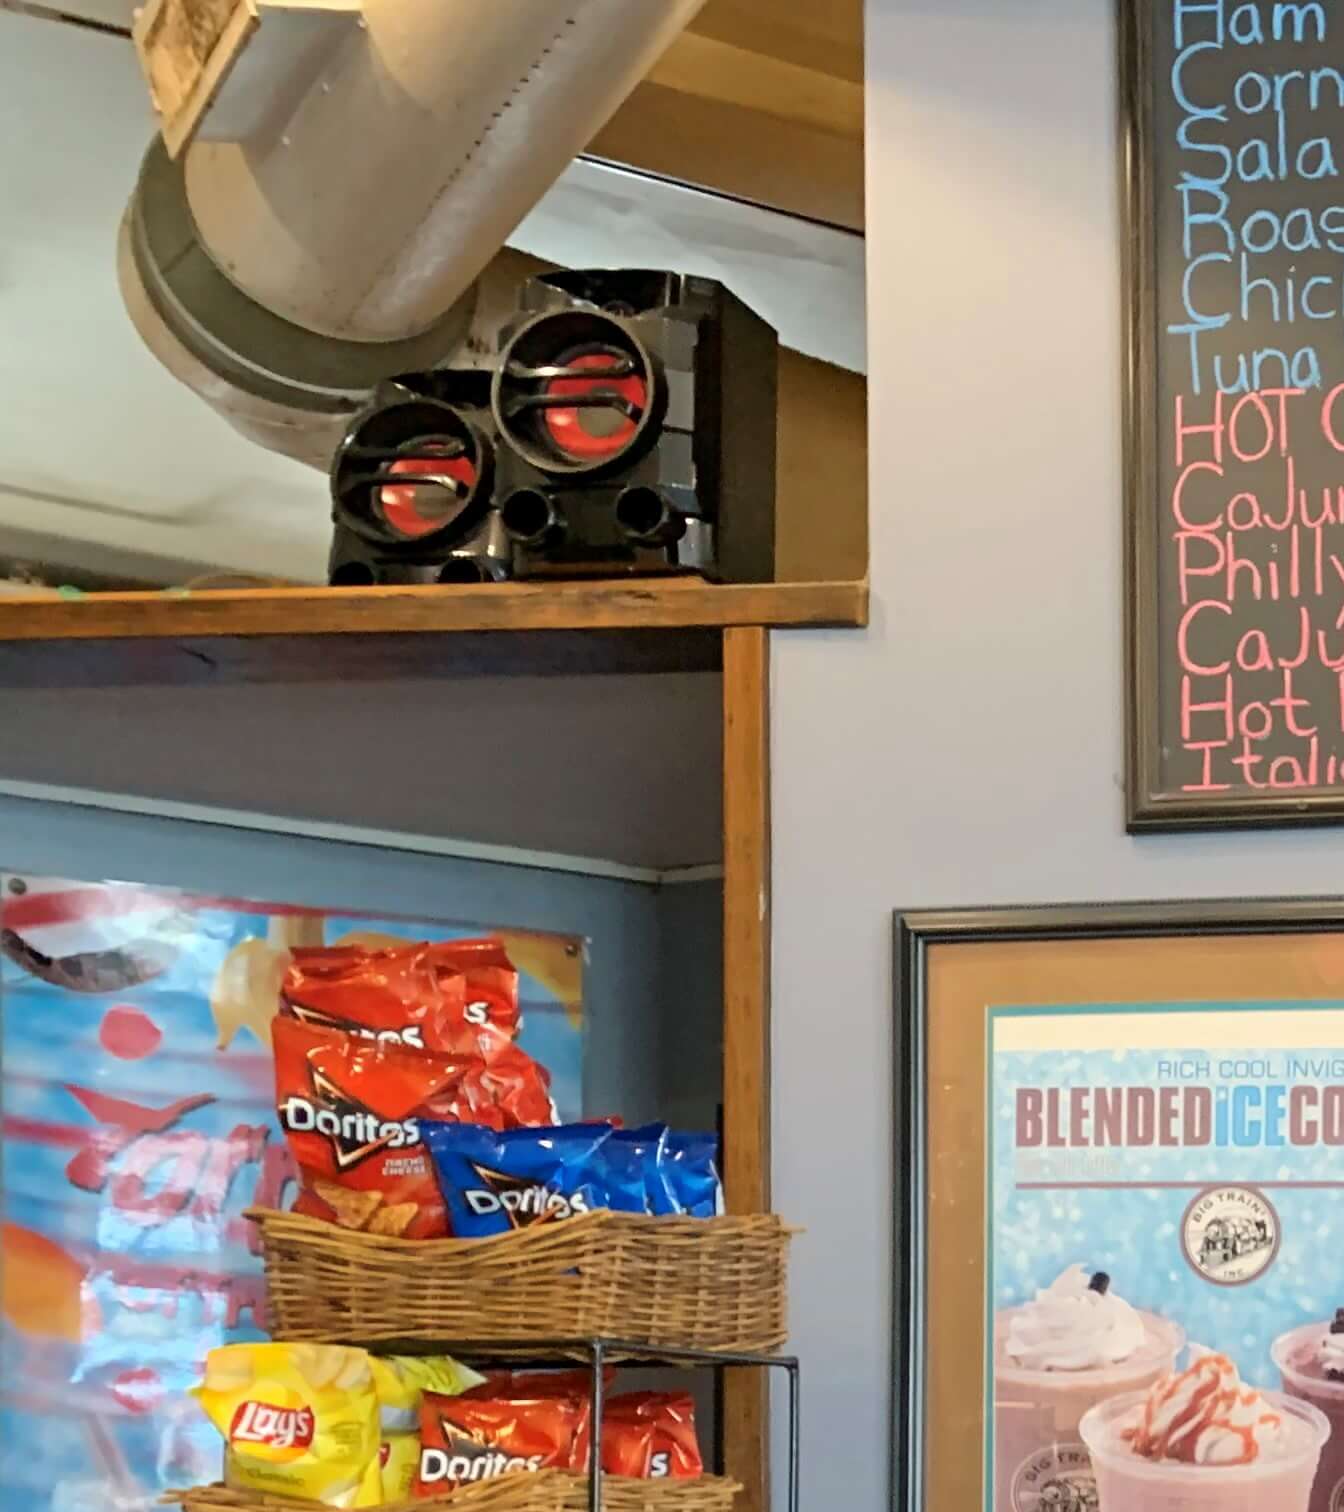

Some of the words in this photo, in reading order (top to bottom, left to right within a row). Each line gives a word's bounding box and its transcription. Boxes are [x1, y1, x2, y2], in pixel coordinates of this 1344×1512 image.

[1173, 0, 1326, 50] Ham
[1168, 318, 1322, 394] Tuna
[1175, 388, 1305, 466] HOT
[1183, 668, 1317, 742] Hot
[1157, 1060, 1210, 1079] RICH
[1219, 1060, 1278, 1079] COOL
[280, 1096, 421, 1148] Doritos
[465, 1187, 589, 1219] Doritos
